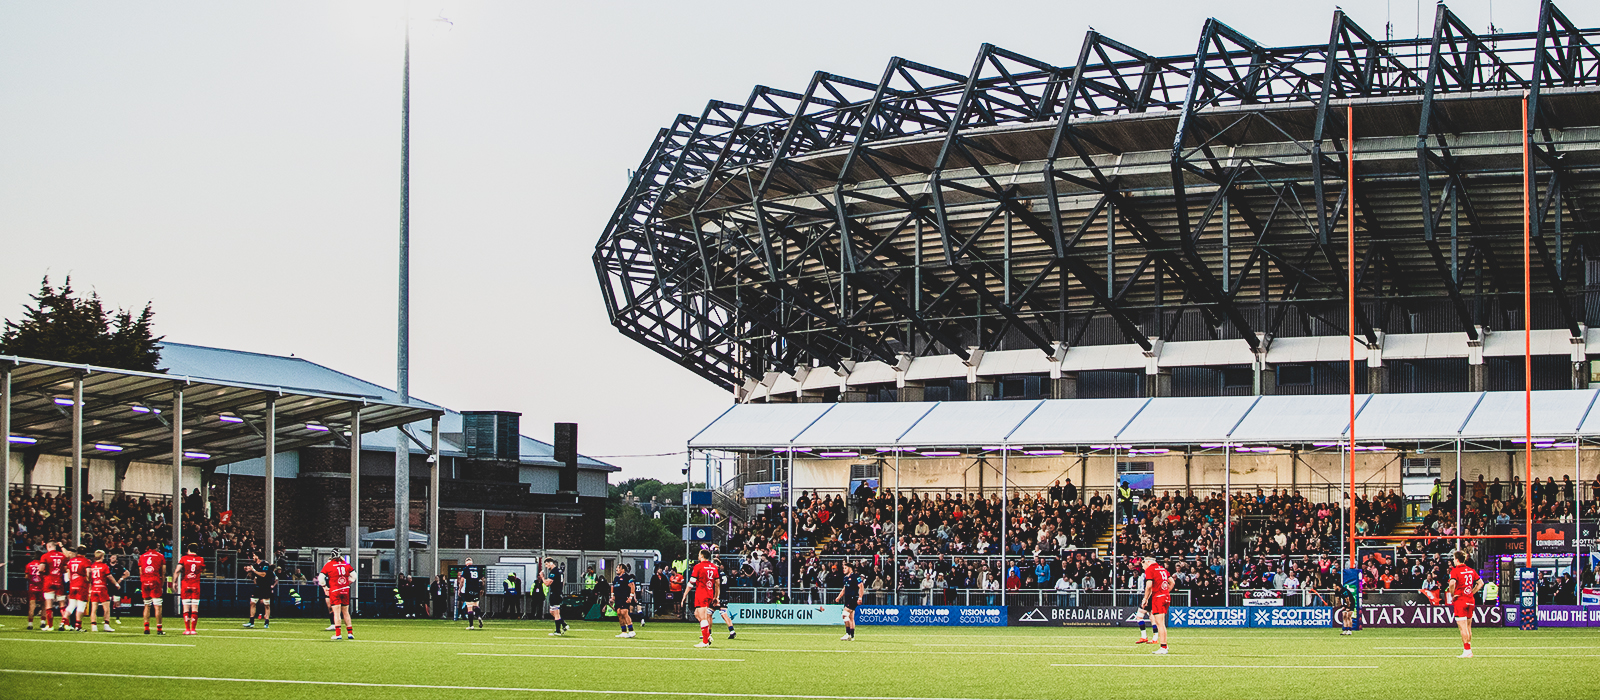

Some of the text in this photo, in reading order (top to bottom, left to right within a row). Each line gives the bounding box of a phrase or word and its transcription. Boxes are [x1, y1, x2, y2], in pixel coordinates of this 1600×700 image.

[1505, 542, 1524, 550] HIVE
[53, 559, 61, 567] 19
[147, 557, 152, 565] 6
[71, 564, 79, 572] 17
[191, 564, 196, 572] 8
[337, 566, 346, 575] 18
[93, 570, 101, 578] 21
[706, 570, 714, 579] 12
[1464, 574, 1473, 585] 23
[740, 608, 812, 620] EDINBURGH GIN
[1051, 608, 1123, 620] BREADALBANE
[1188, 609, 1246, 619] SCOTTISH
[1272, 609, 1331, 619] SCOTTISH
[1538, 611, 1568, 621] NLOAD
[1571, 611, 1587, 621] THE
